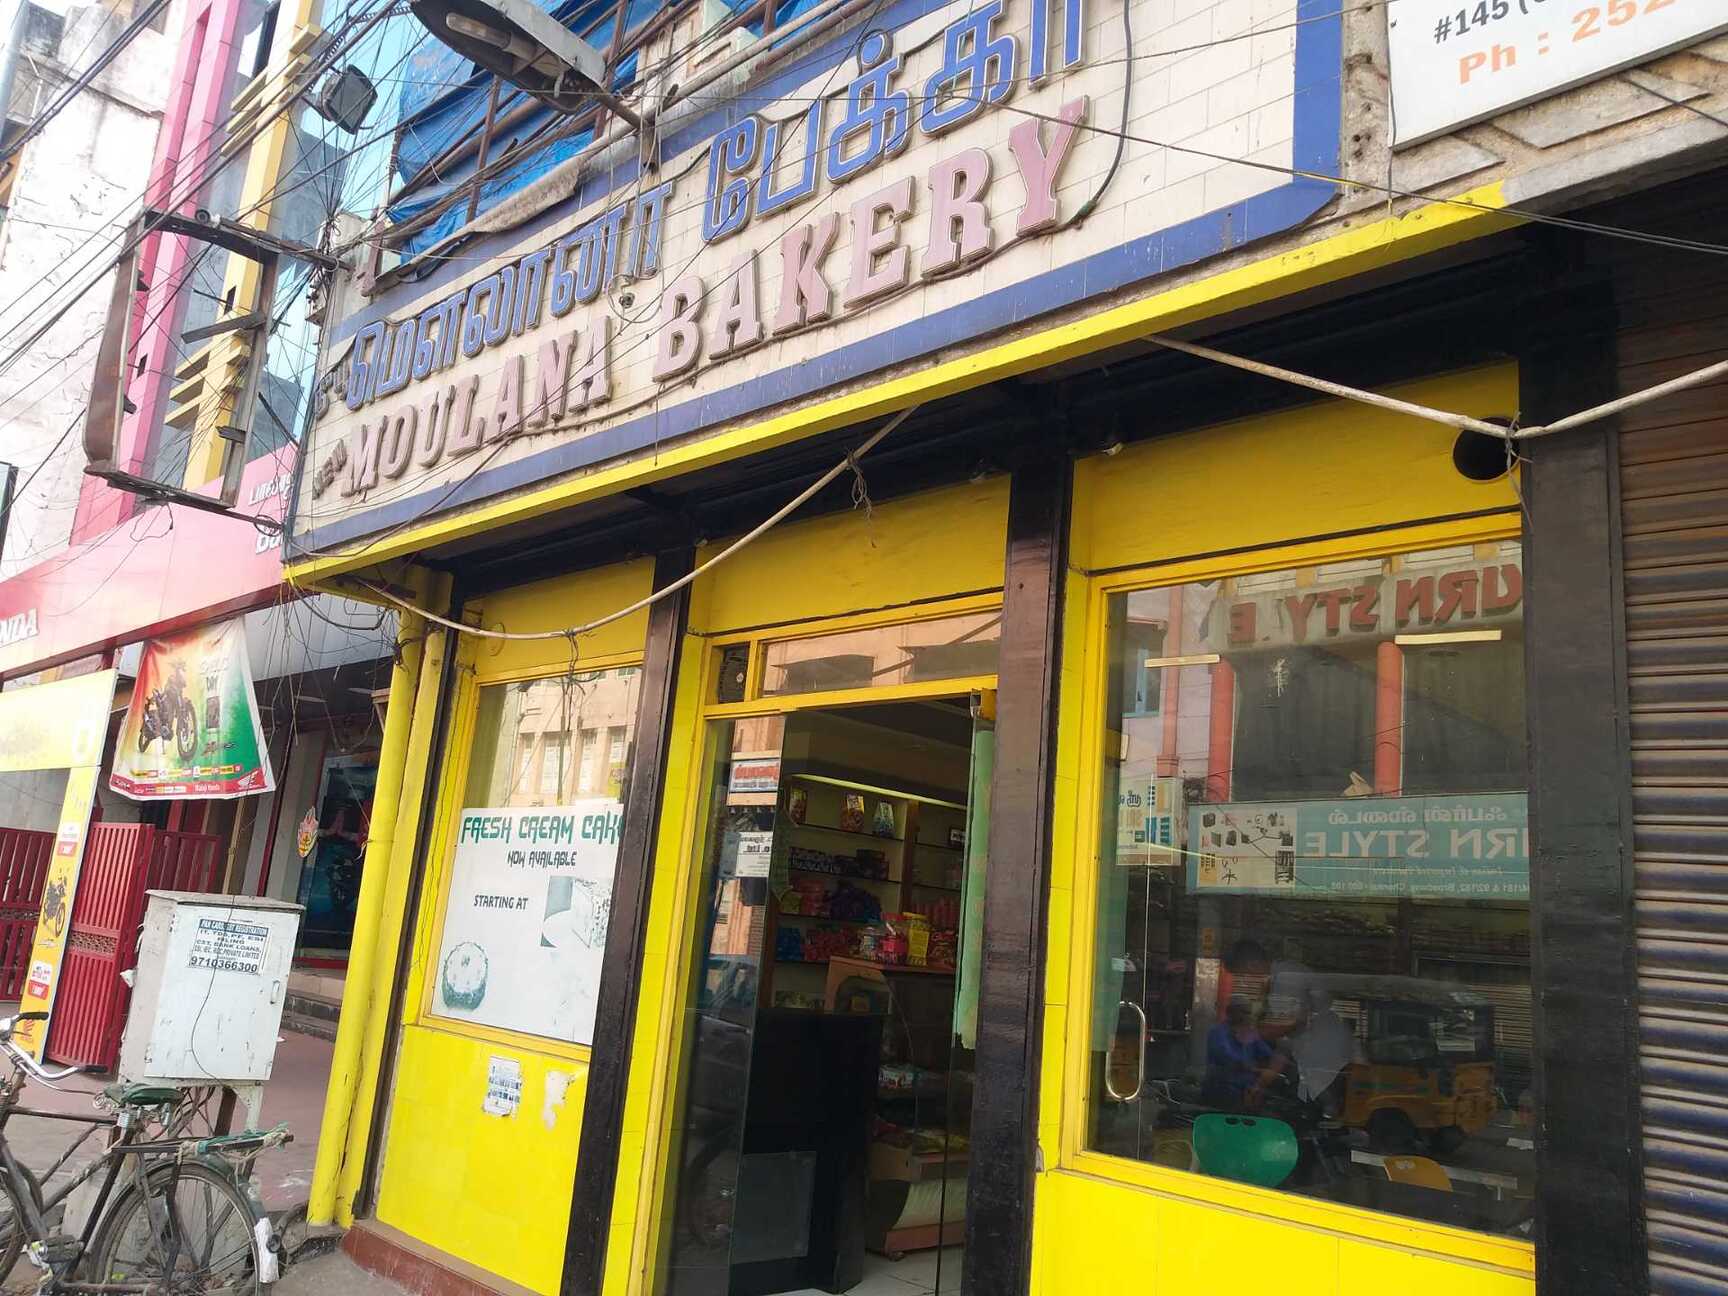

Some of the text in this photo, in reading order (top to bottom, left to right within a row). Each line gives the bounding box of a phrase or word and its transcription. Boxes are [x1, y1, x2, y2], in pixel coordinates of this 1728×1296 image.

[1434, 0, 1509, 44] #145
[1459, 43, 1516, 85] Ph
[340, 315, 613, 498] MOULANA
[652, 95, 1090, 383] BAKERY
[461, 815, 511, 845] FRESH
[518, 814, 575, 844] CREAM
[507, 850, 578, 868] NOW AVAILABLE
[473, 894, 529, 910] STARTING AT
